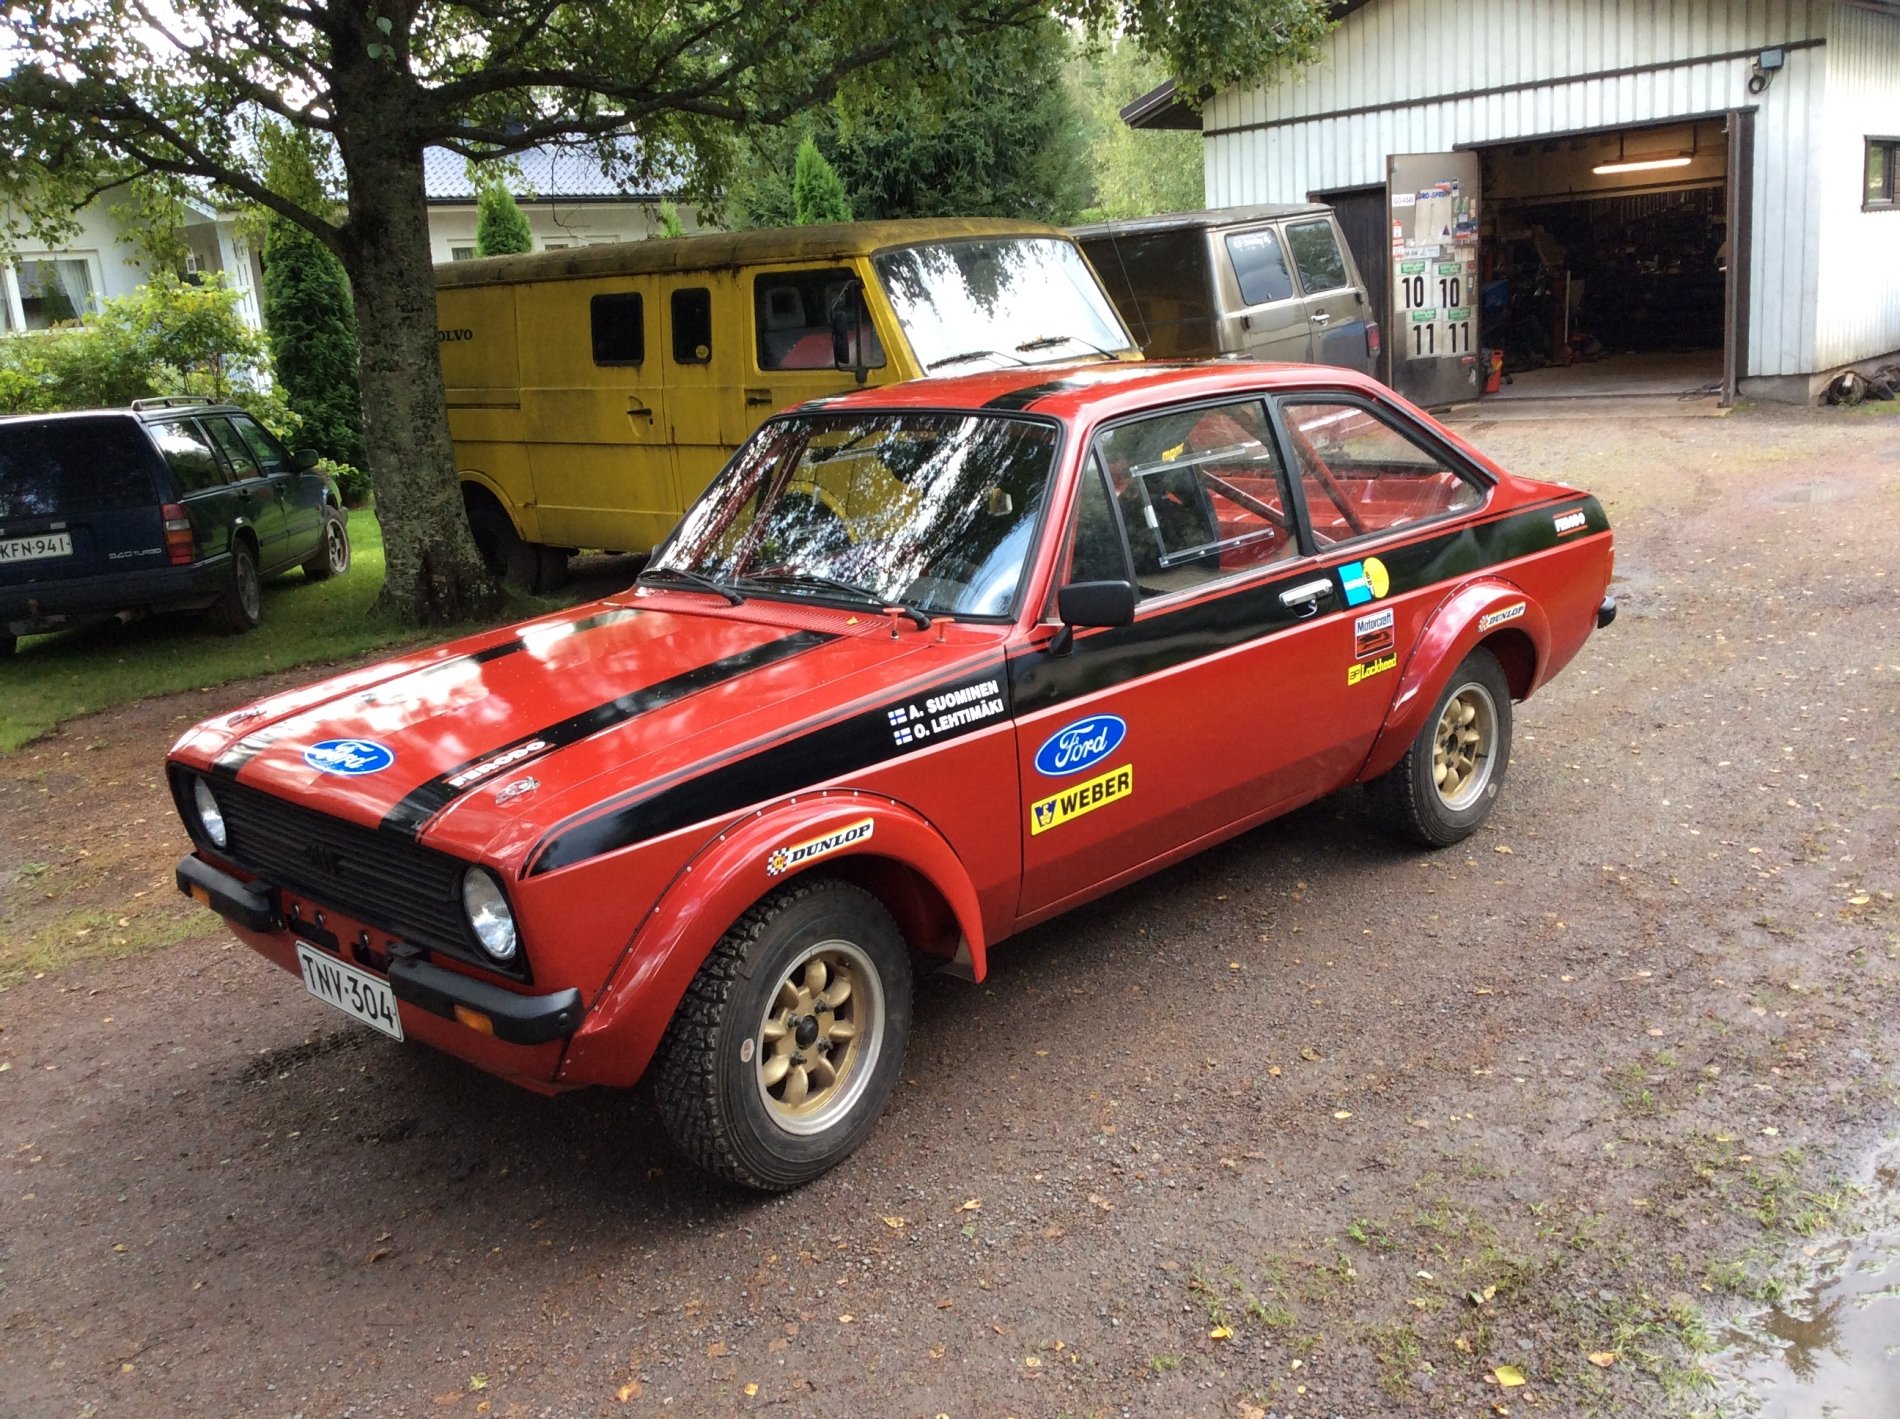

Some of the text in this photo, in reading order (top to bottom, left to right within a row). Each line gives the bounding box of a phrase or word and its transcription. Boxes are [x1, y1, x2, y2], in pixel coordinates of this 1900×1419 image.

[1402, 275, 1424, 309] 10
[1439, 277, 1460, 309] 10
[437, 328, 473, 342] OLVO
[1413, 323, 1434, 356] 11
[1448, 321, 1469, 353] 11
[1357, 611, 1392, 634] Motorcraft
[1488, 605, 1524, 625] DUNLOP
[908, 679, 999, 721] A. SUOMINEN
[913, 698, 1005, 739] O. LEHTIMÄKI
[1054, 724, 1108, 769] Ford
[1060, 771, 1130, 816] WEBER
[790, 824, 871, 863] DUNLOP
[302, 953, 394, 1029] TNV-304
